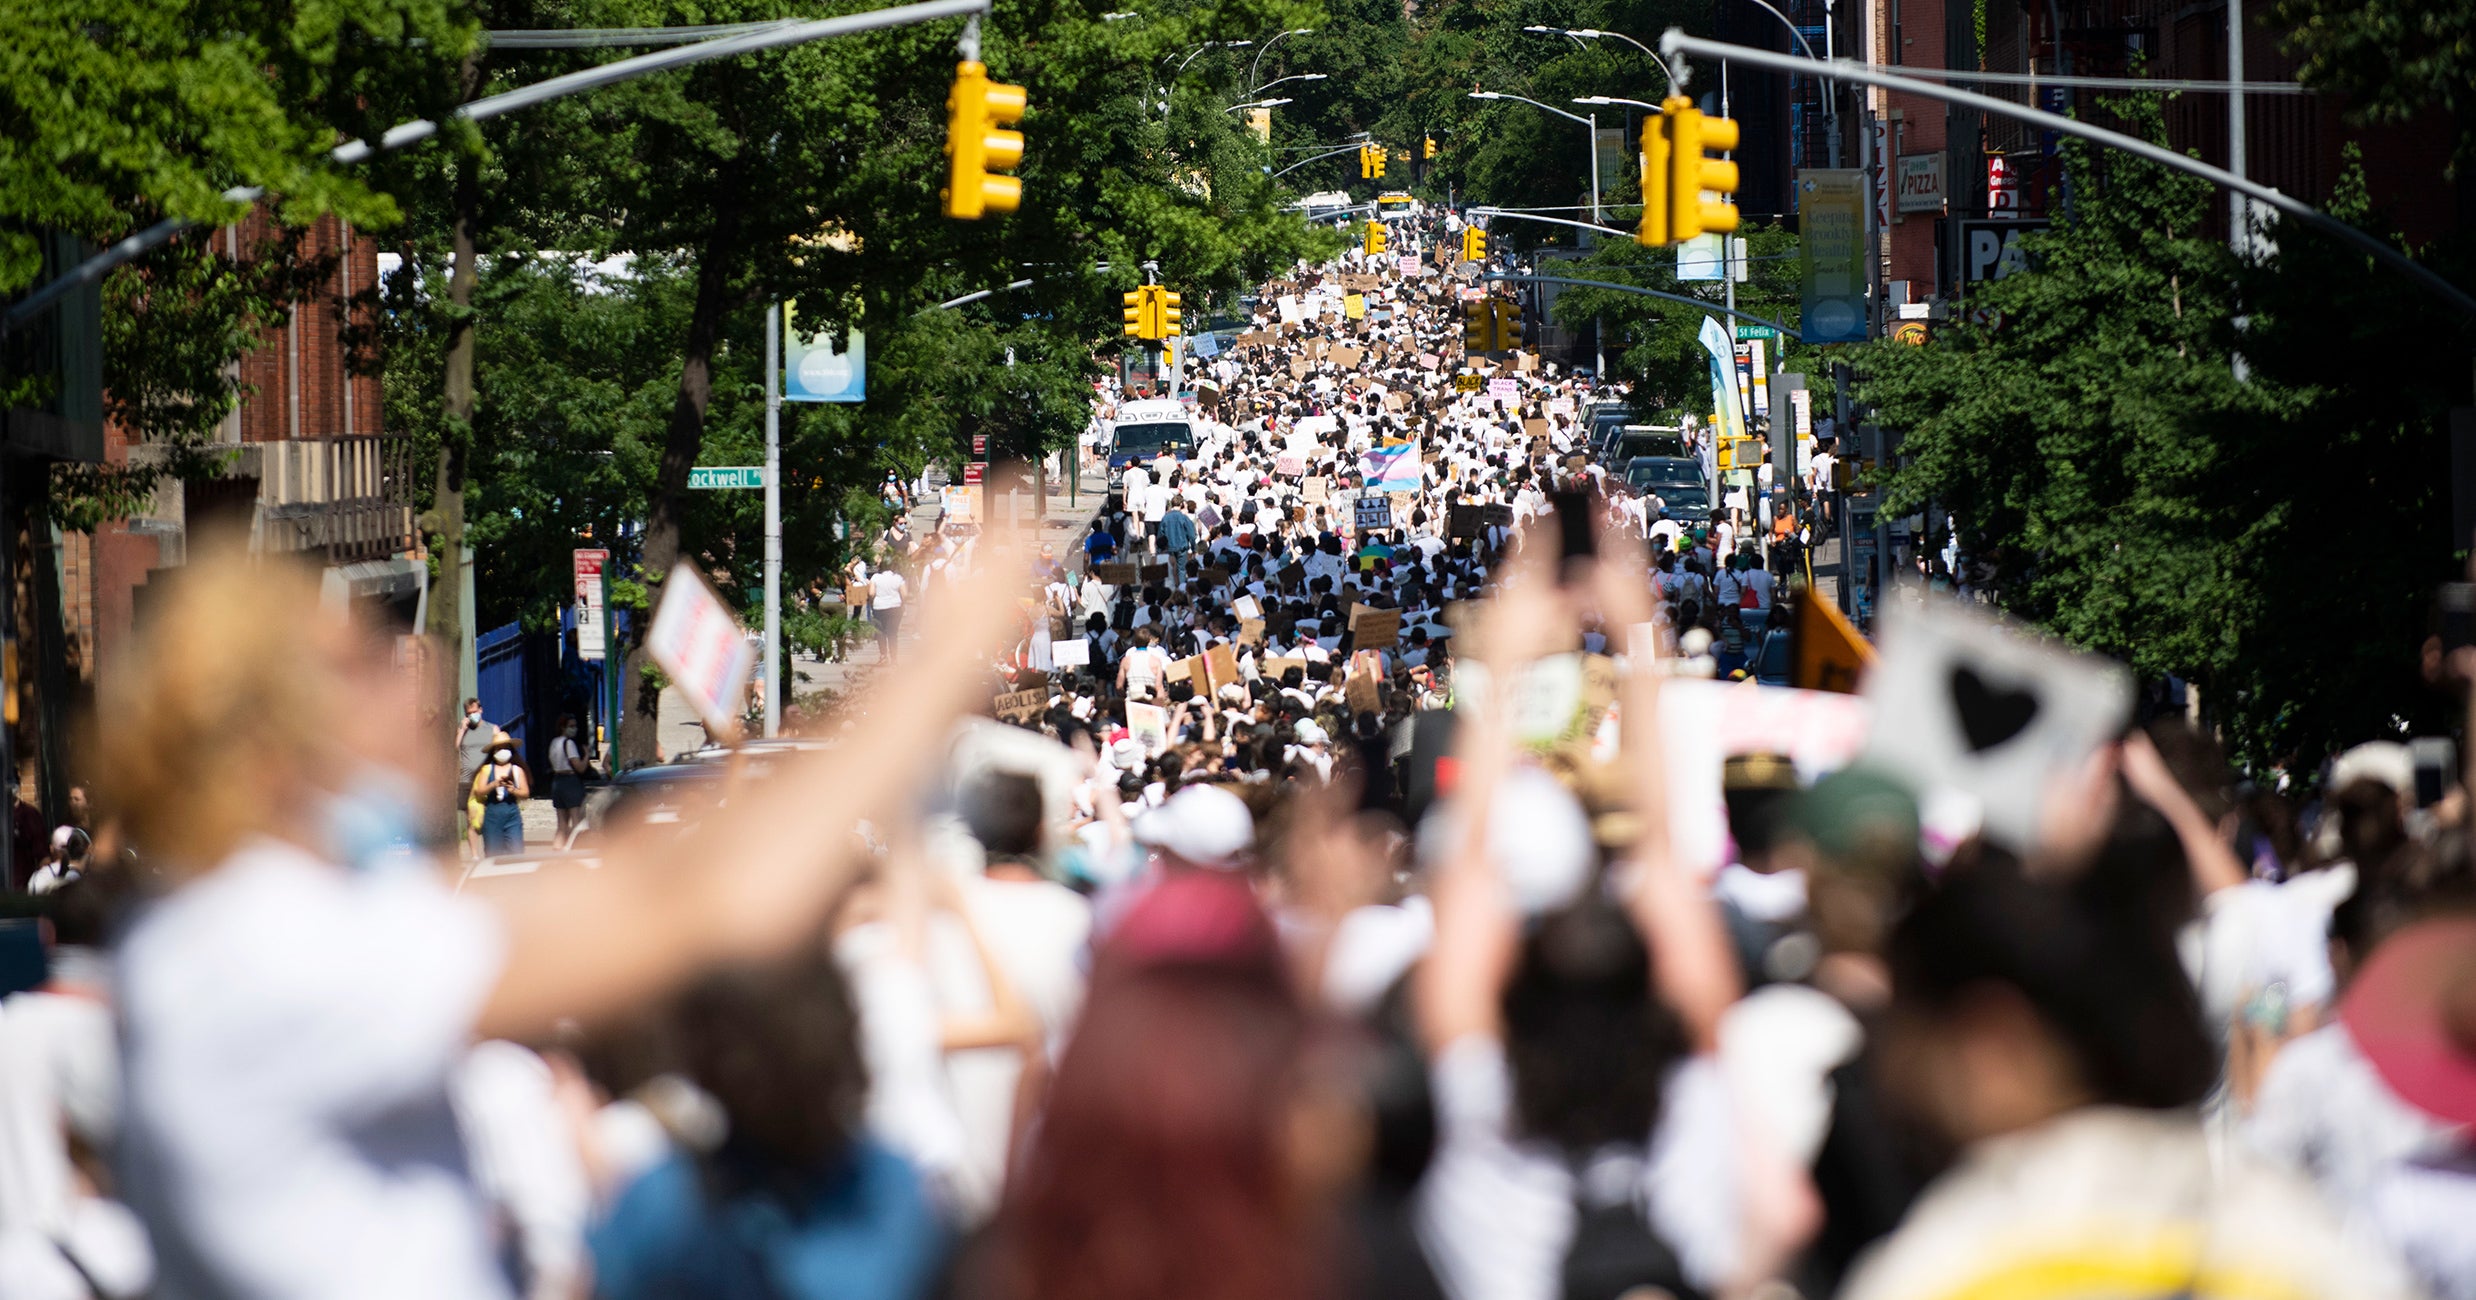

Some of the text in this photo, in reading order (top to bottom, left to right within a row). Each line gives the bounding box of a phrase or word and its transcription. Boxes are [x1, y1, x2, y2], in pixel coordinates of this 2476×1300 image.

[1992, 155, 2004, 172] A
[1907, 173, 1939, 195] PIZZA
[1806, 210, 1859, 226] Keeping
[1804, 226, 1861, 243] Brooklyn
[1808, 242, 1856, 260] Healthy
[1739, 326, 1770, 337] St Felix
[1457, 376, 1480, 386] BLACK
[688, 469, 749, 486] ockwell
[997, 690, 1046, 711] ABOLISH
